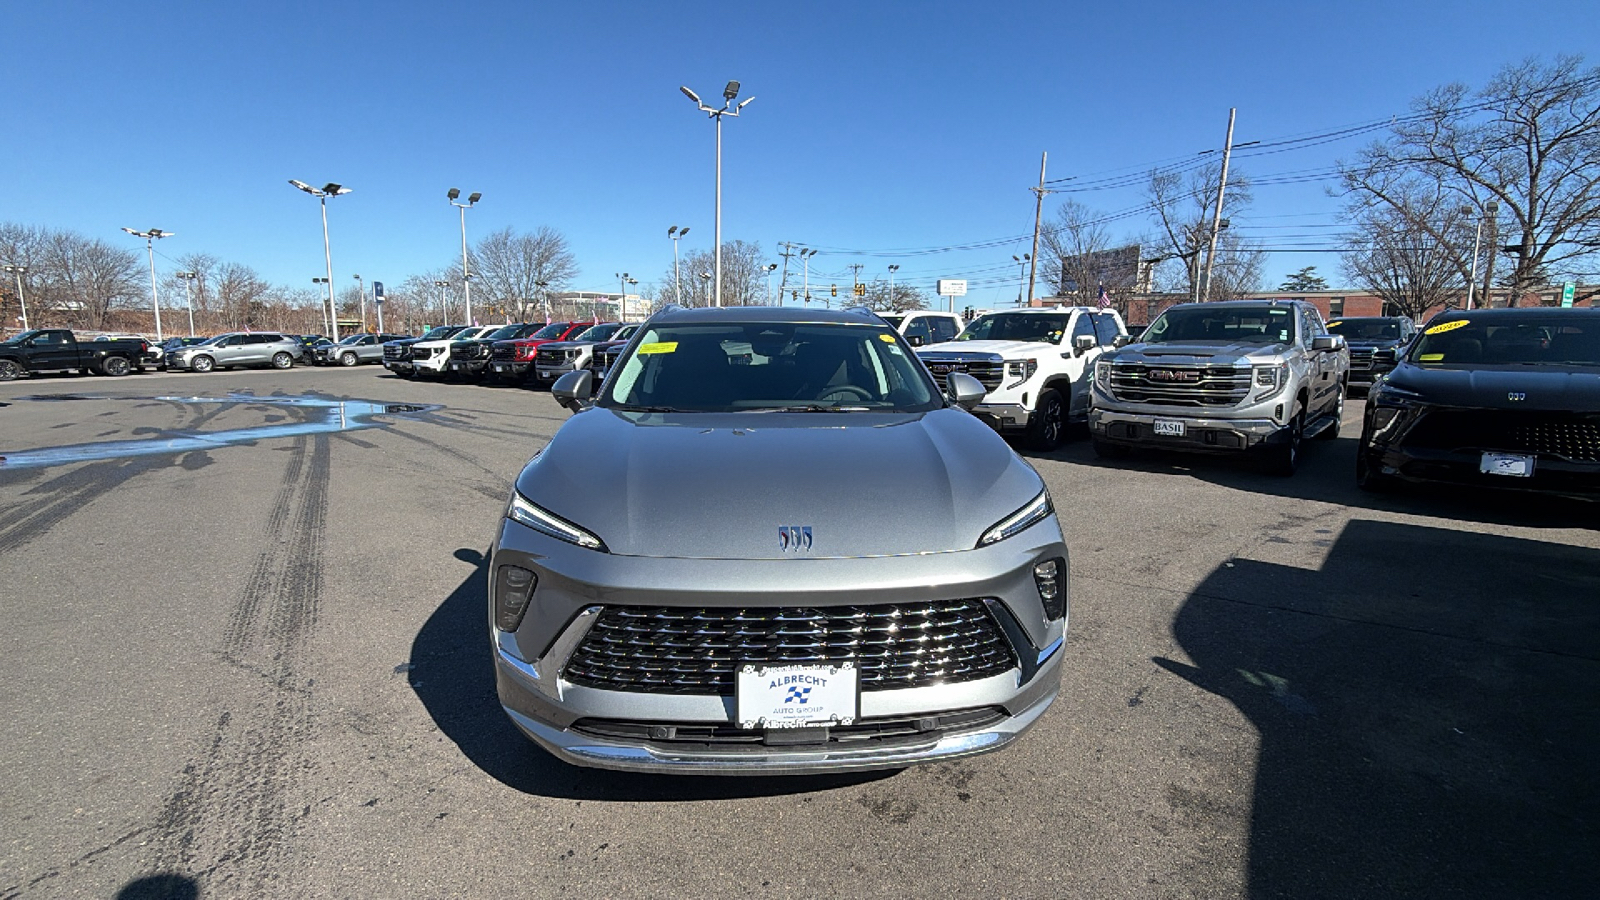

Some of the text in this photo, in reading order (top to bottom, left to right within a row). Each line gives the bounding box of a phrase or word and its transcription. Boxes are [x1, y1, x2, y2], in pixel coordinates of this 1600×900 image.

[1149, 369, 1200, 381] GMC
[1154, 422, 1183, 433] BASIL
[768, 674, 828, 690] ALBRECHT
[772, 706, 824, 715] AUTO GROUP
[763, 718, 807, 729] Albrecht
